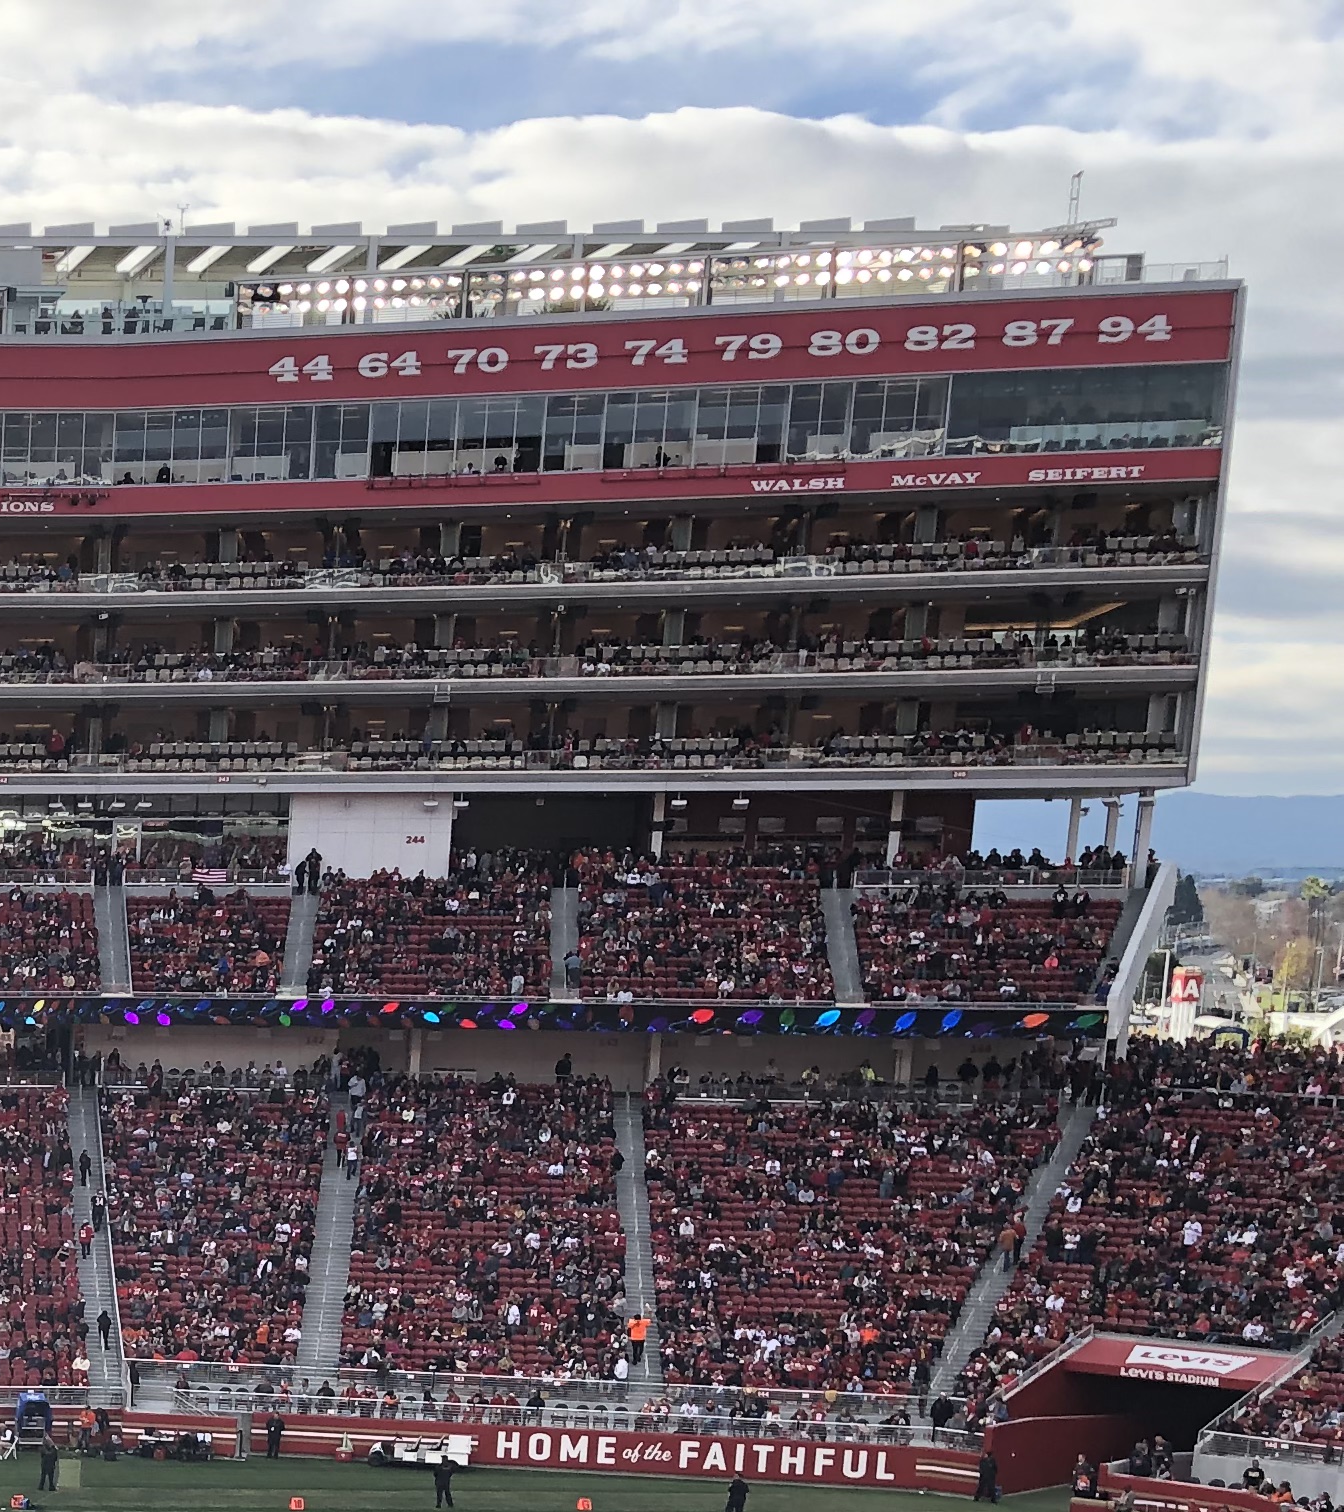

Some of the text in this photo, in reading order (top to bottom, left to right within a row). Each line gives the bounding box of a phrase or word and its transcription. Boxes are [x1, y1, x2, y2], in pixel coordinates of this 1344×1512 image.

[268, 314, 1173, 382] 44 64 70 73 74 79 80 82 87 94
[1027, 464, 1147, 481] SEIFERT
[750, 477, 847, 492] WALSH
[405, 835, 425, 844] 244
[1166, 1372, 1220, 1387] STADIUM
[495, 1430, 896, 1480] HOME of the FAITHFUL
